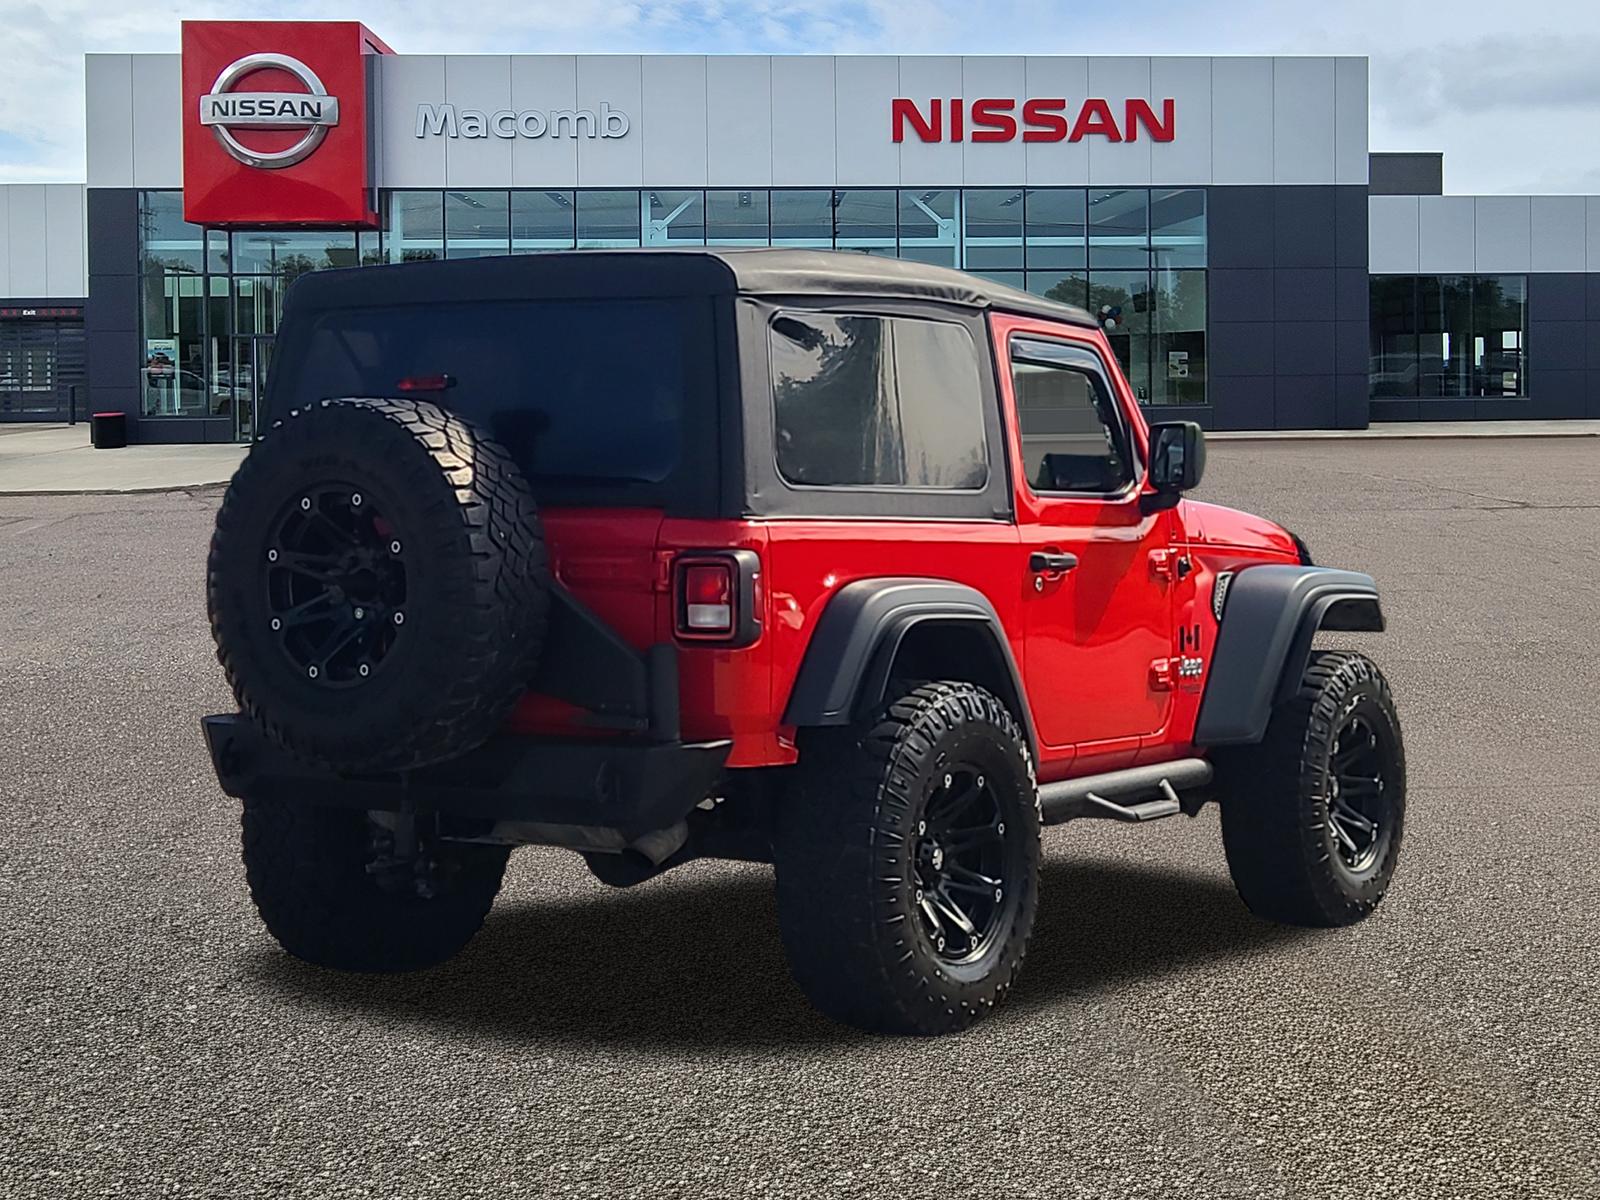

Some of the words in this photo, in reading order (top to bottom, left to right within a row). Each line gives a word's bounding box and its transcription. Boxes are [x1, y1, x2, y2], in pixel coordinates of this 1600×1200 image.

[212, 100, 322, 117] NISSAN
[415, 102, 630, 139] Macomb
[892, 98, 1175, 143] NISSAN
